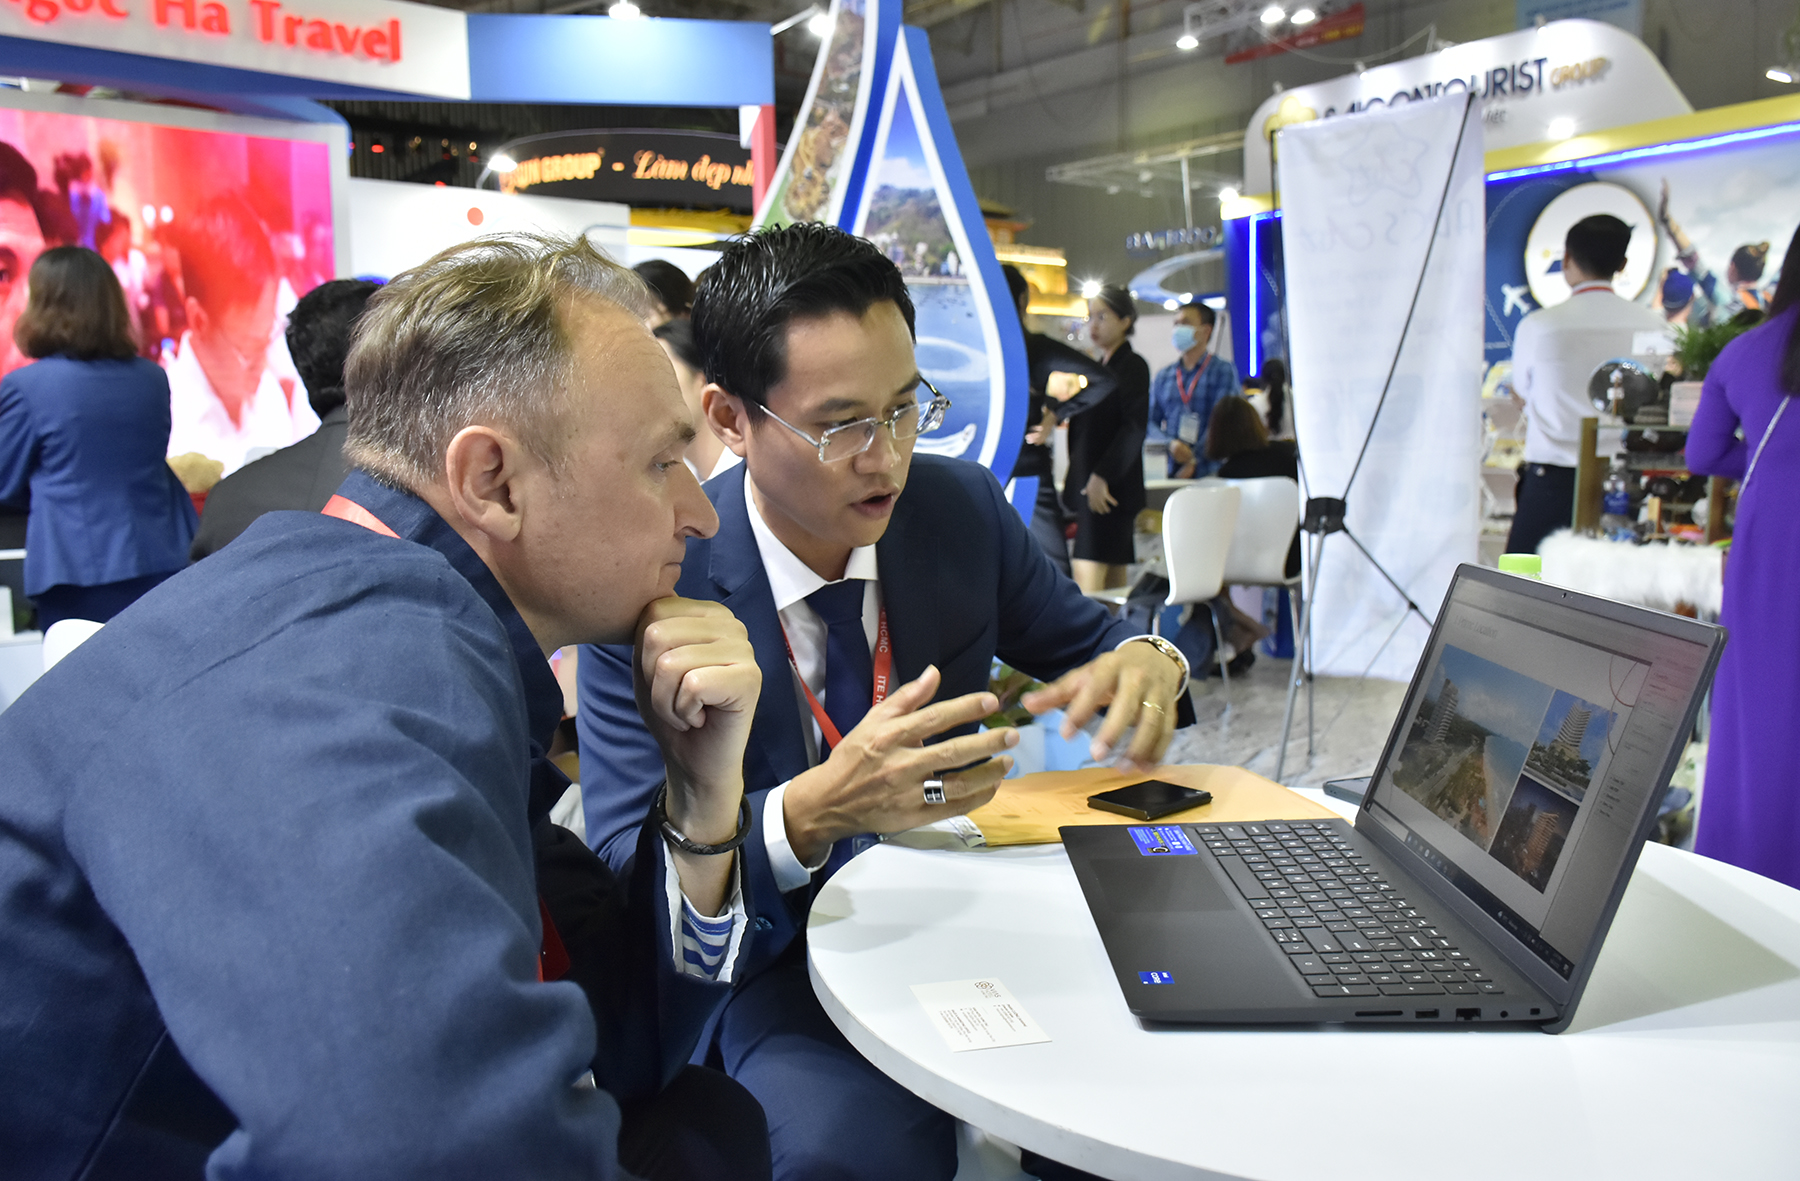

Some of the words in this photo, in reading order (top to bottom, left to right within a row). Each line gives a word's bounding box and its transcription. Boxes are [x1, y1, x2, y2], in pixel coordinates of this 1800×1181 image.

[248, 0, 402, 61] Travel
[1324, 57, 1548, 118] TOURIST
[1550, 57, 1608, 87] GROUP
[541, 152, 602, 183] GROUP
[879, 621, 888, 653] HCMC
[876, 675, 886, 693] ITE
